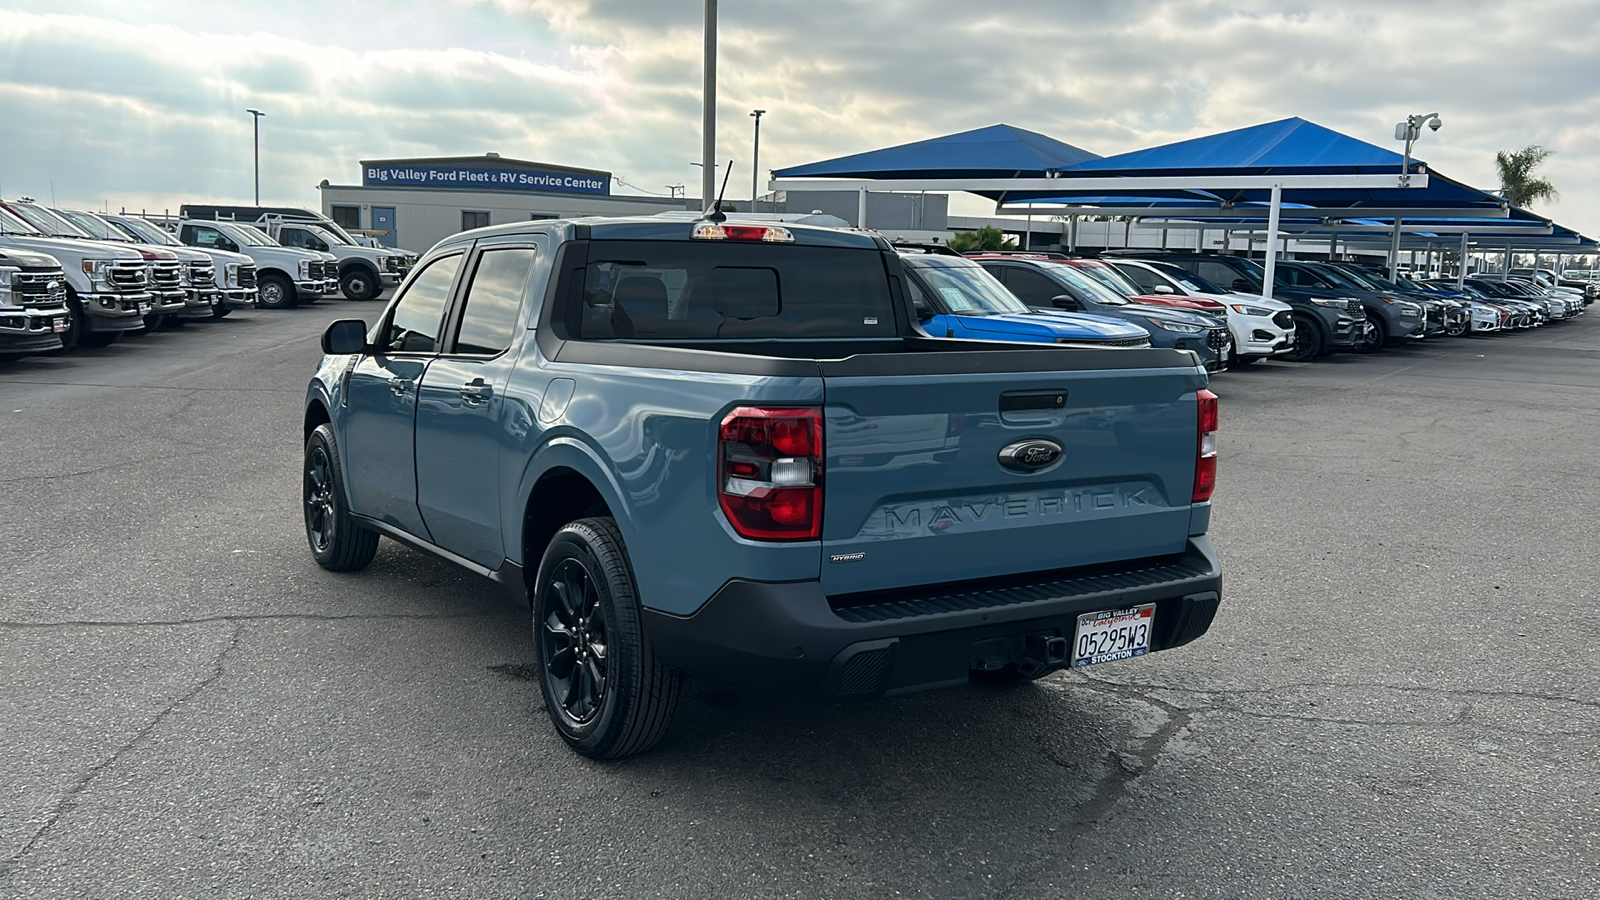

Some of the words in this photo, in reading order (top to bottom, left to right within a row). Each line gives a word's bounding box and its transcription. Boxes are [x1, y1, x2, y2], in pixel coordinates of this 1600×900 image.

[368, 168, 388, 181] Big
[390, 169, 427, 182] Valley
[429, 170, 457, 181] Ford
[459, 171, 489, 182] Fleet
[491, 174, 498, 183] &
[500, 172, 517, 183] RV
[519, 174, 562, 186] Service
[564, 177, 602, 190] Center
[1025, 447, 1052, 463] Ford
[885, 489, 1148, 530] MAVERICK
[1097, 612, 1111, 620] BIG
[1112, 607, 1139, 617] VALLEY
[1078, 624, 1148, 658] 05295W3
[1091, 649, 1133, 664] STOCKTON
